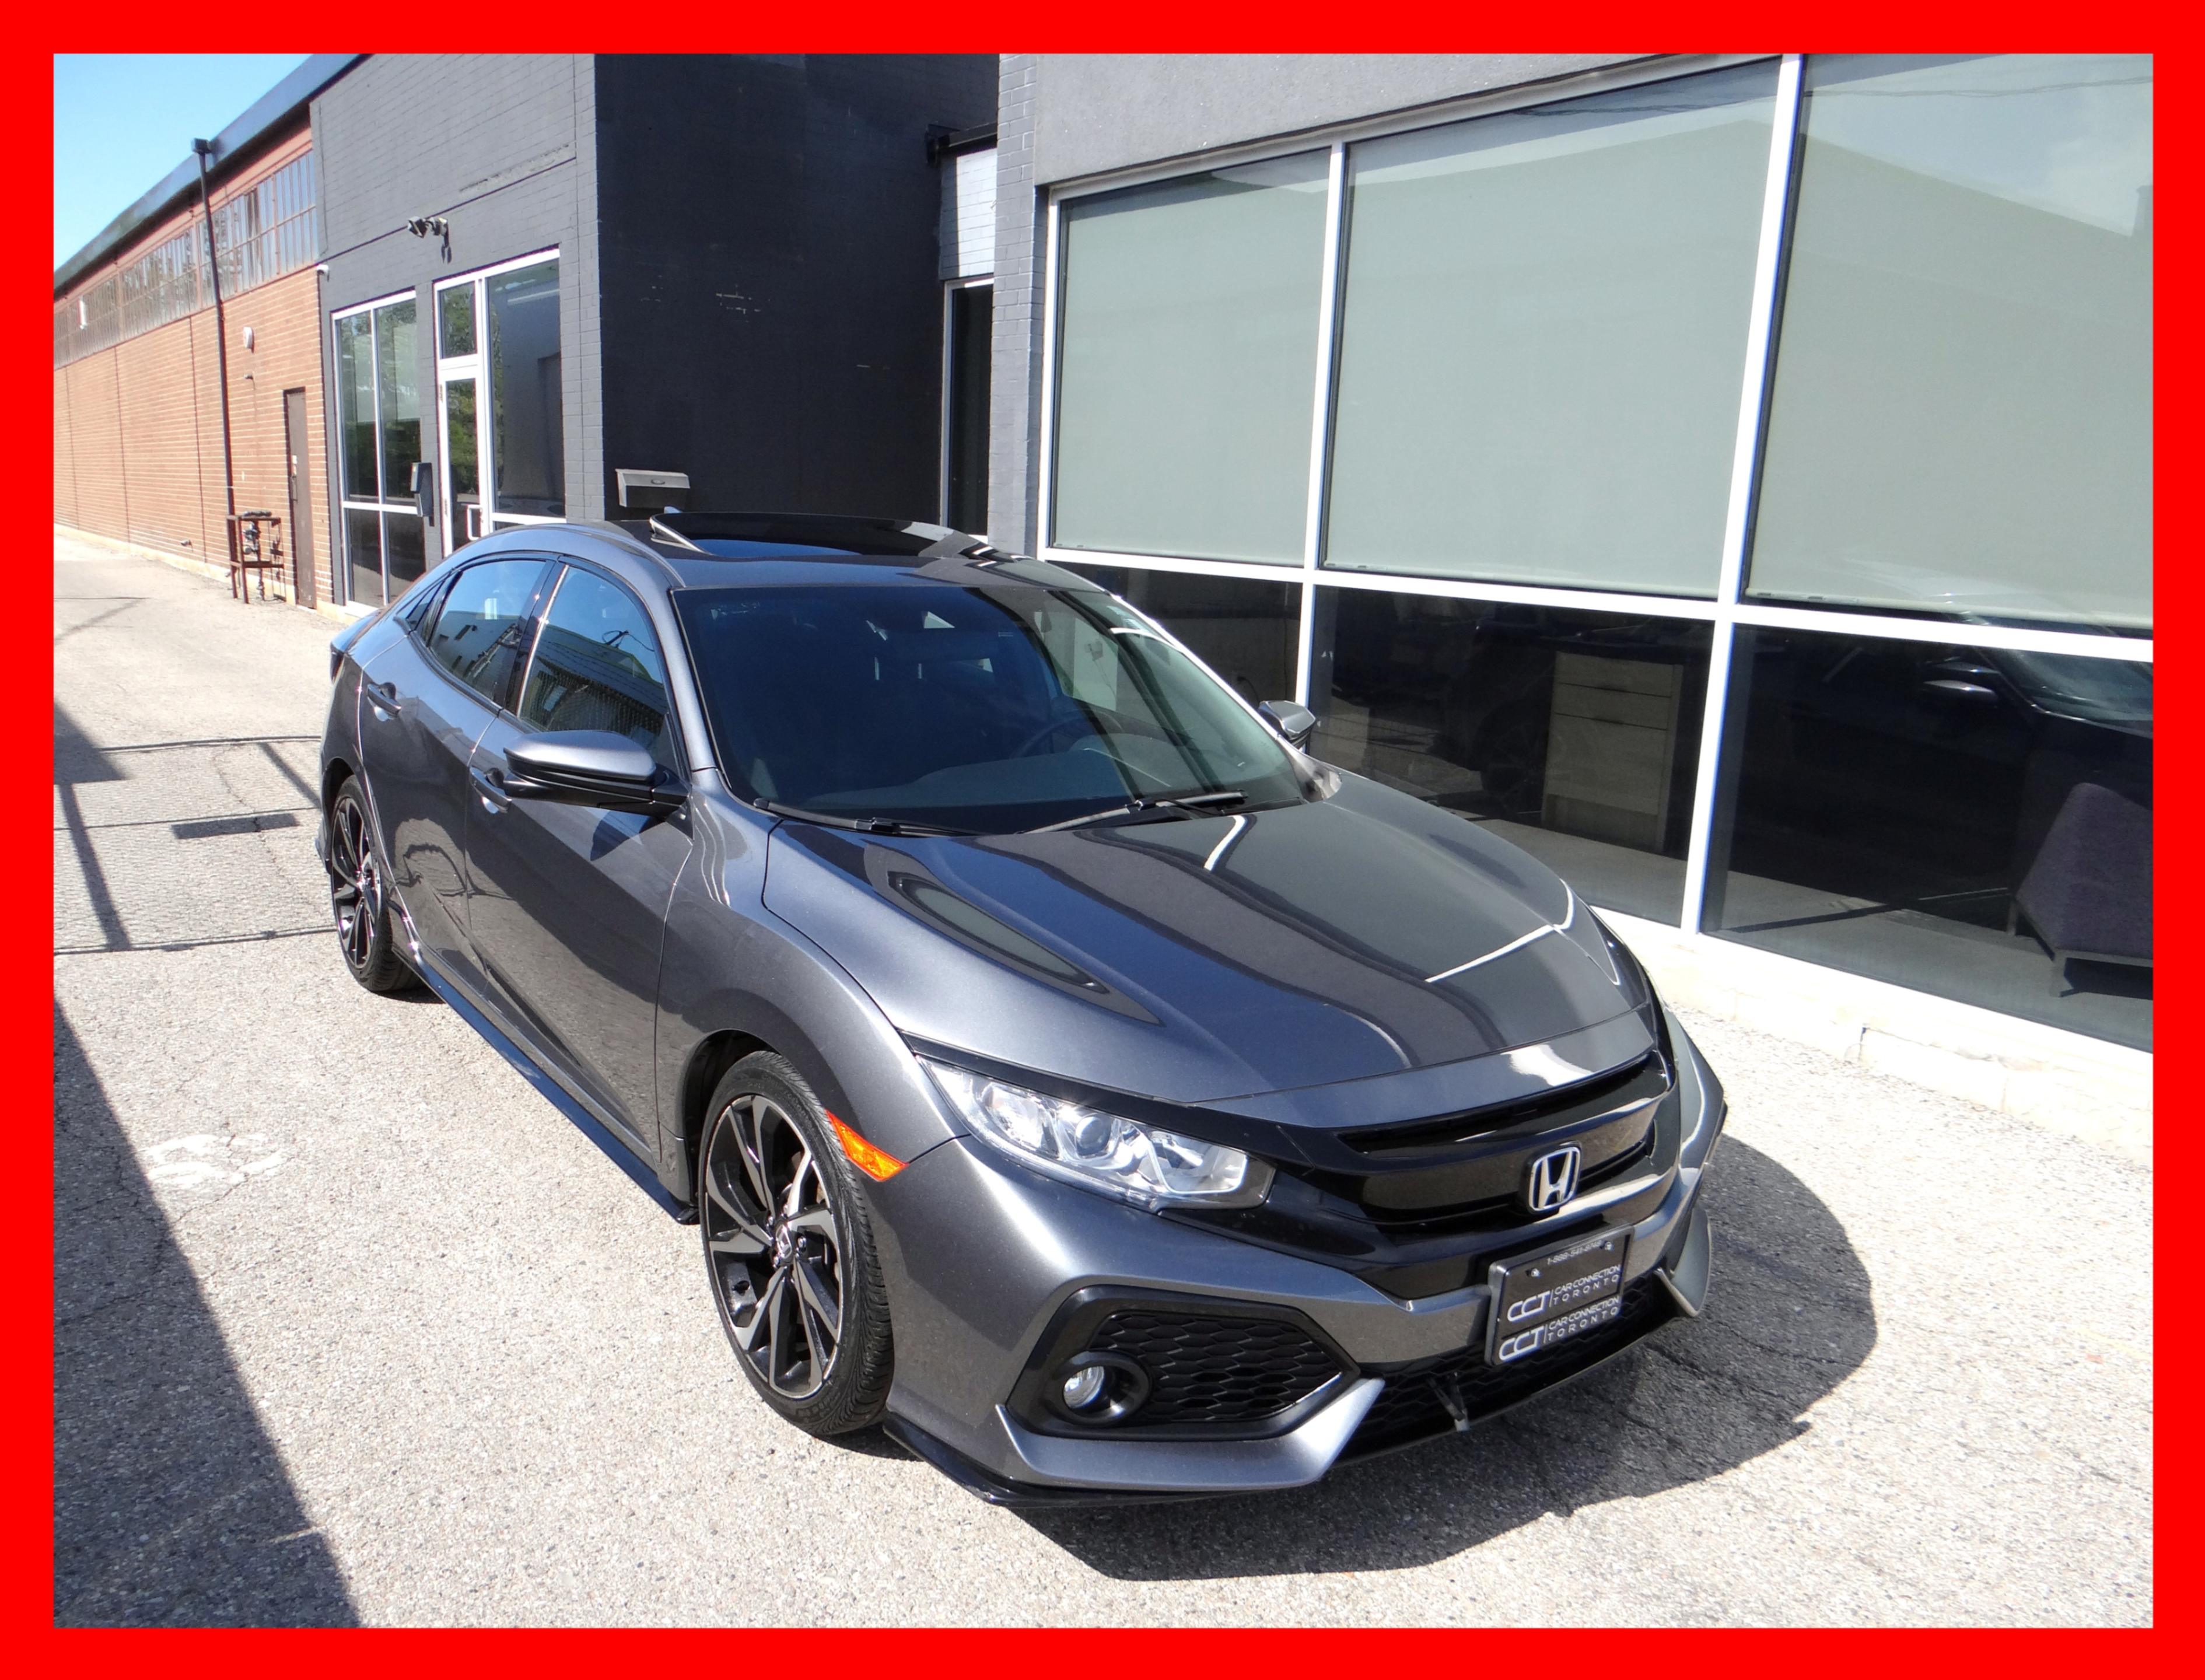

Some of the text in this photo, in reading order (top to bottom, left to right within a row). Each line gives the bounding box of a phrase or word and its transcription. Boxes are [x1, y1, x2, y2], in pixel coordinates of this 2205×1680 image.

[1553, 1274, 1620, 1305] TORONTO
[1554, 1264, 1621, 1295] CAR CONNECTION
[1548, 1306, 1619, 1341] TORONTO
[1549, 1296, 1620, 1330] CAR CONNECTION
